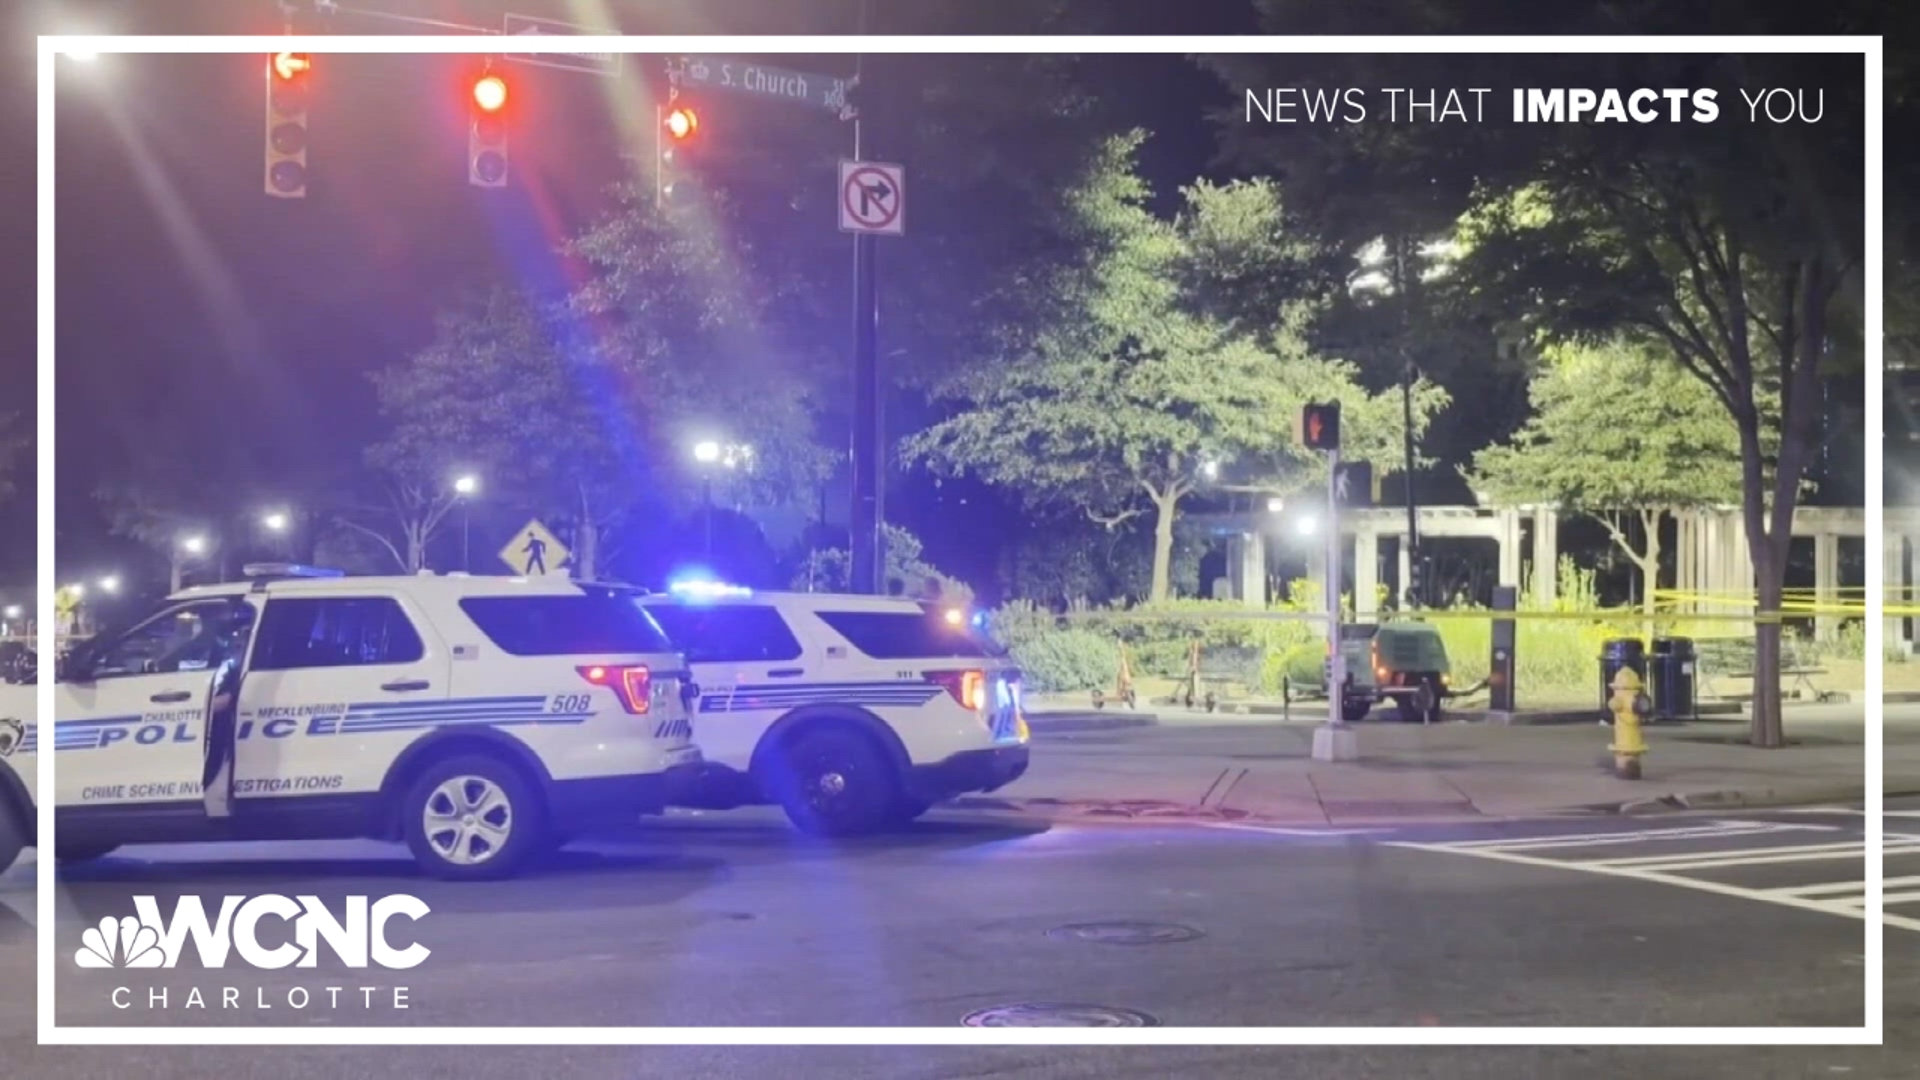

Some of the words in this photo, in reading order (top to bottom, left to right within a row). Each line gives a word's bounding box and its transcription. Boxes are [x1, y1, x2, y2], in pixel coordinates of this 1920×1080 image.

[719, 63, 737, 88] S.
[743, 66, 808, 99] Church
[143, 708, 203, 723] CHARLOTTE
[256, 702, 347, 719] MECKLENBURG
[551, 693, 592, 714] 508
[81, 784, 125, 800] CRIME
[129, 782, 176, 798] SCENE
